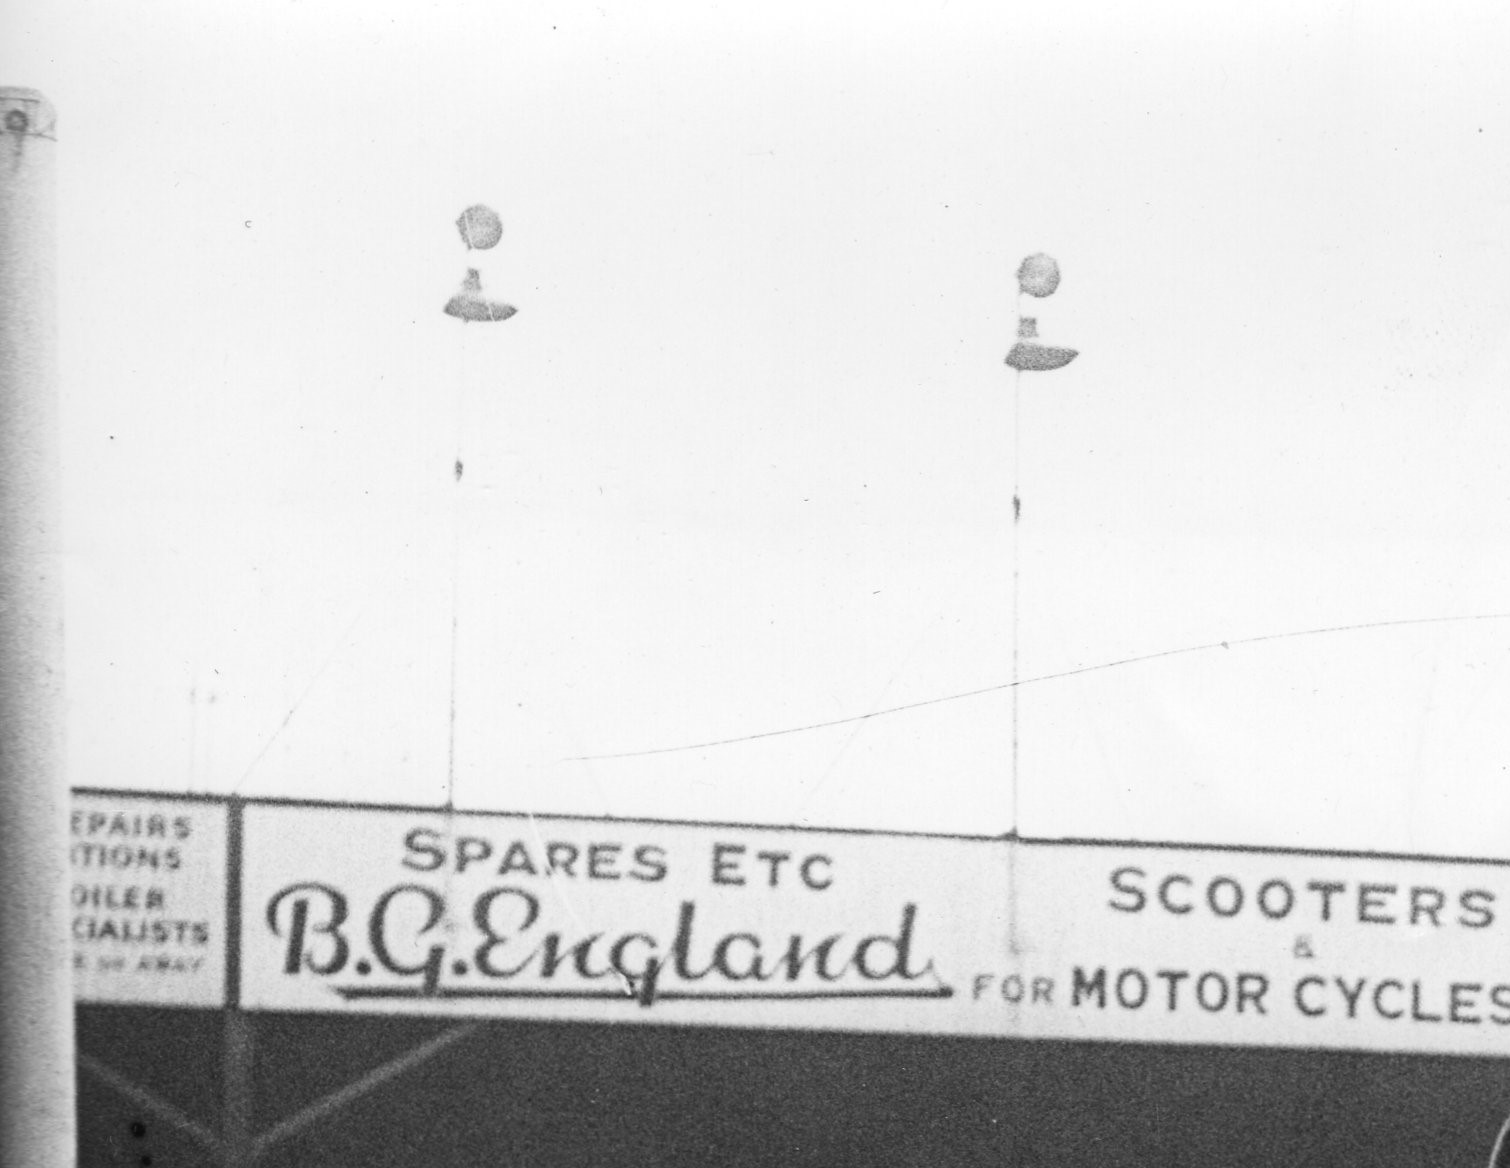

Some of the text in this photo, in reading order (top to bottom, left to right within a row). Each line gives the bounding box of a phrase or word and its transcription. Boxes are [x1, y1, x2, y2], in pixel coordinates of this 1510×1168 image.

[402, 826, 834, 891] SPARES ETC
[1107, 865, 1497, 929] SCOOTERS
[1291, 933, 1316, 960] &
[970, 972, 1056, 1004] FOR
[1071, 966, 1269, 1015] MOTOR
